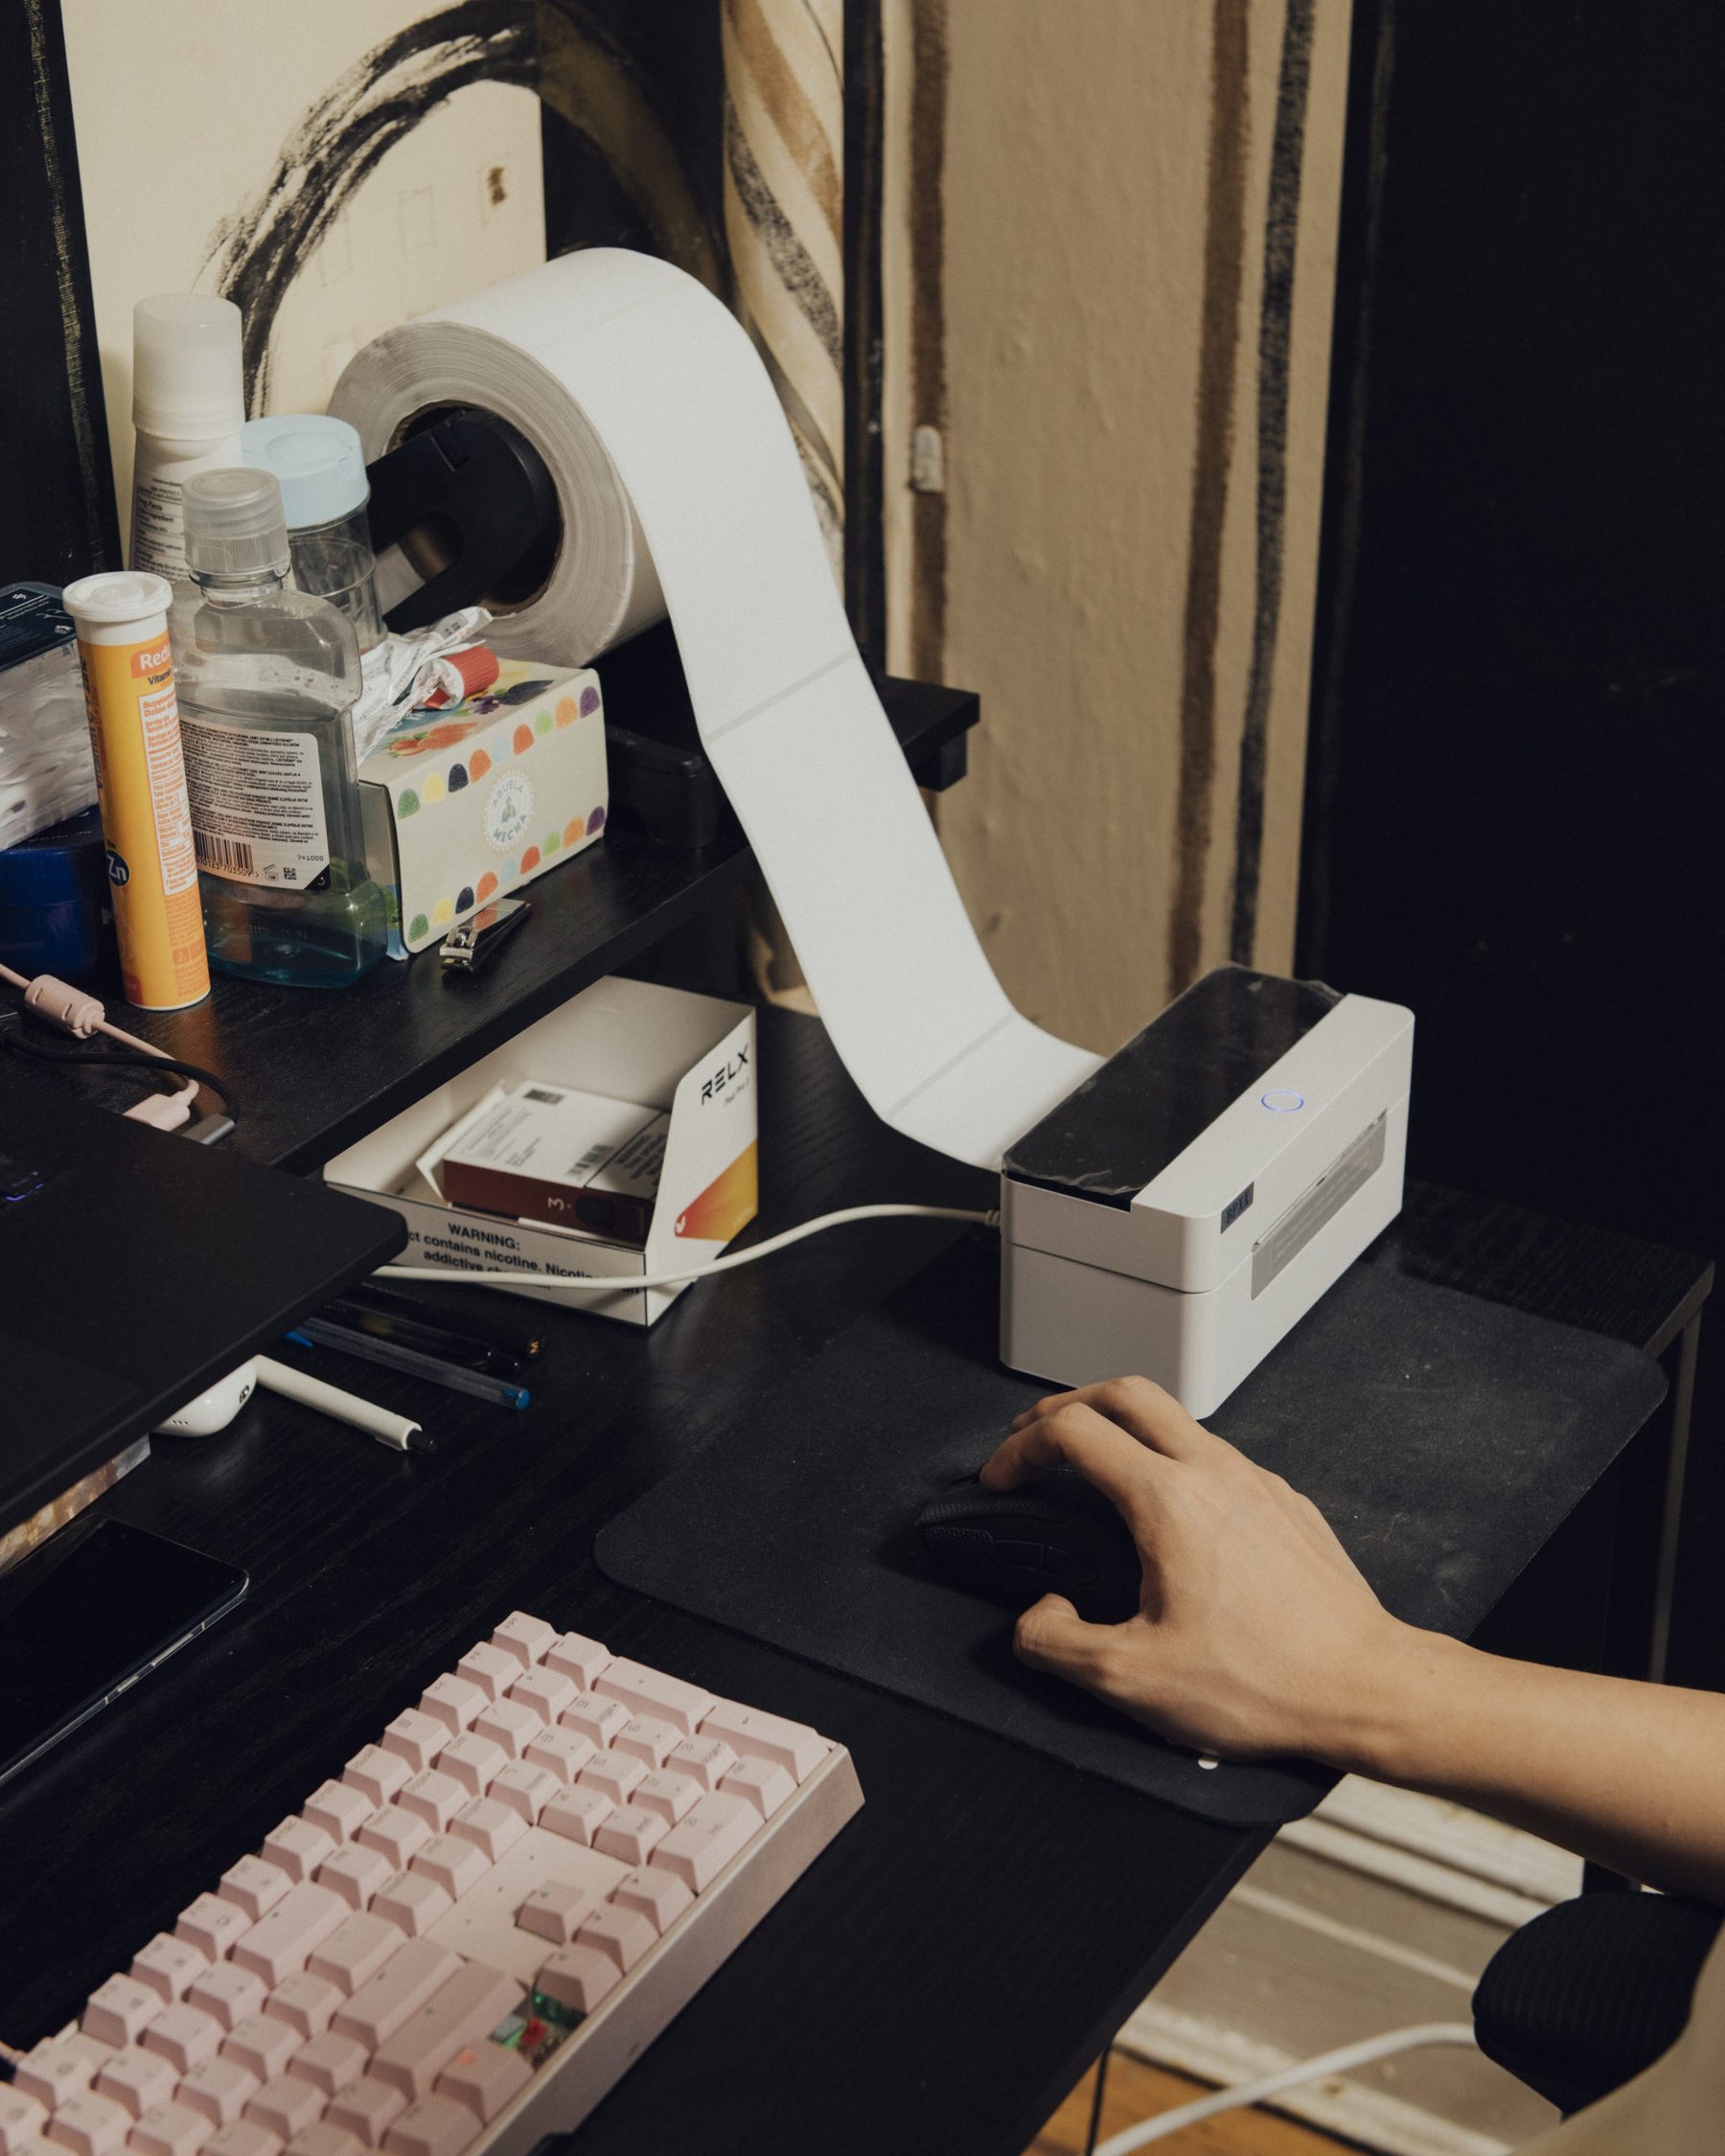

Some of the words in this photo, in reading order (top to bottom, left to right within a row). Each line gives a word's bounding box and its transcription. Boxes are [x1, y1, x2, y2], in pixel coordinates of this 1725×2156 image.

[106, 853, 127, 882] Zn
[296, 853, 324, 863] 741000
[701, 1044, 749, 1106] RELX
[448, 1222, 521, 1251] WARNING:
[424, 1234, 481, 1257] contains
[484, 1249, 542, 1273] nicotine.
[424, 1250, 484, 1273] addictive
